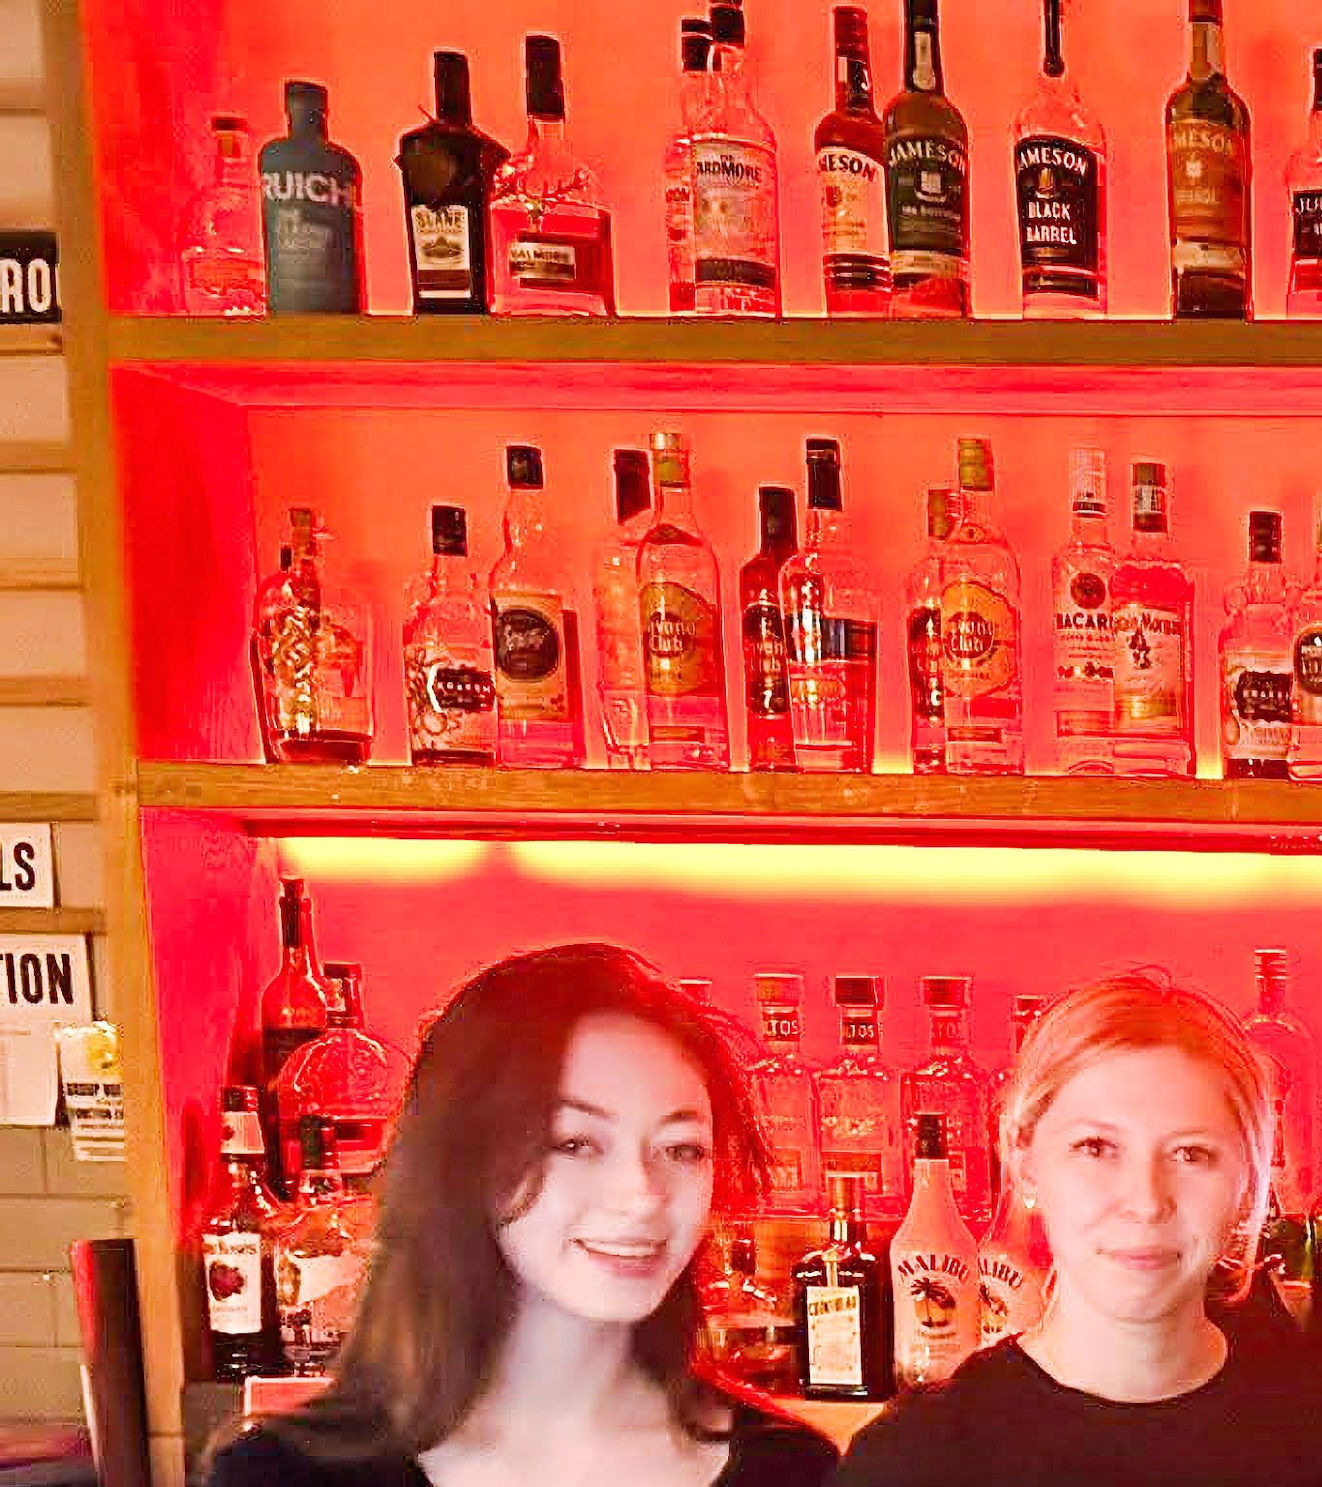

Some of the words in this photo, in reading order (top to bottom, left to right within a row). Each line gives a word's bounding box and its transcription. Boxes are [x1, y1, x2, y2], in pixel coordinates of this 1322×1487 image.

[1028, 200, 1071, 221] BLACK
[1026, 225, 1077, 246] BARREL
[1057, 612, 1116, 631] BACAR
[0, 952, 74, 1005] ION
[898, 1253, 970, 1283] MALIBU
